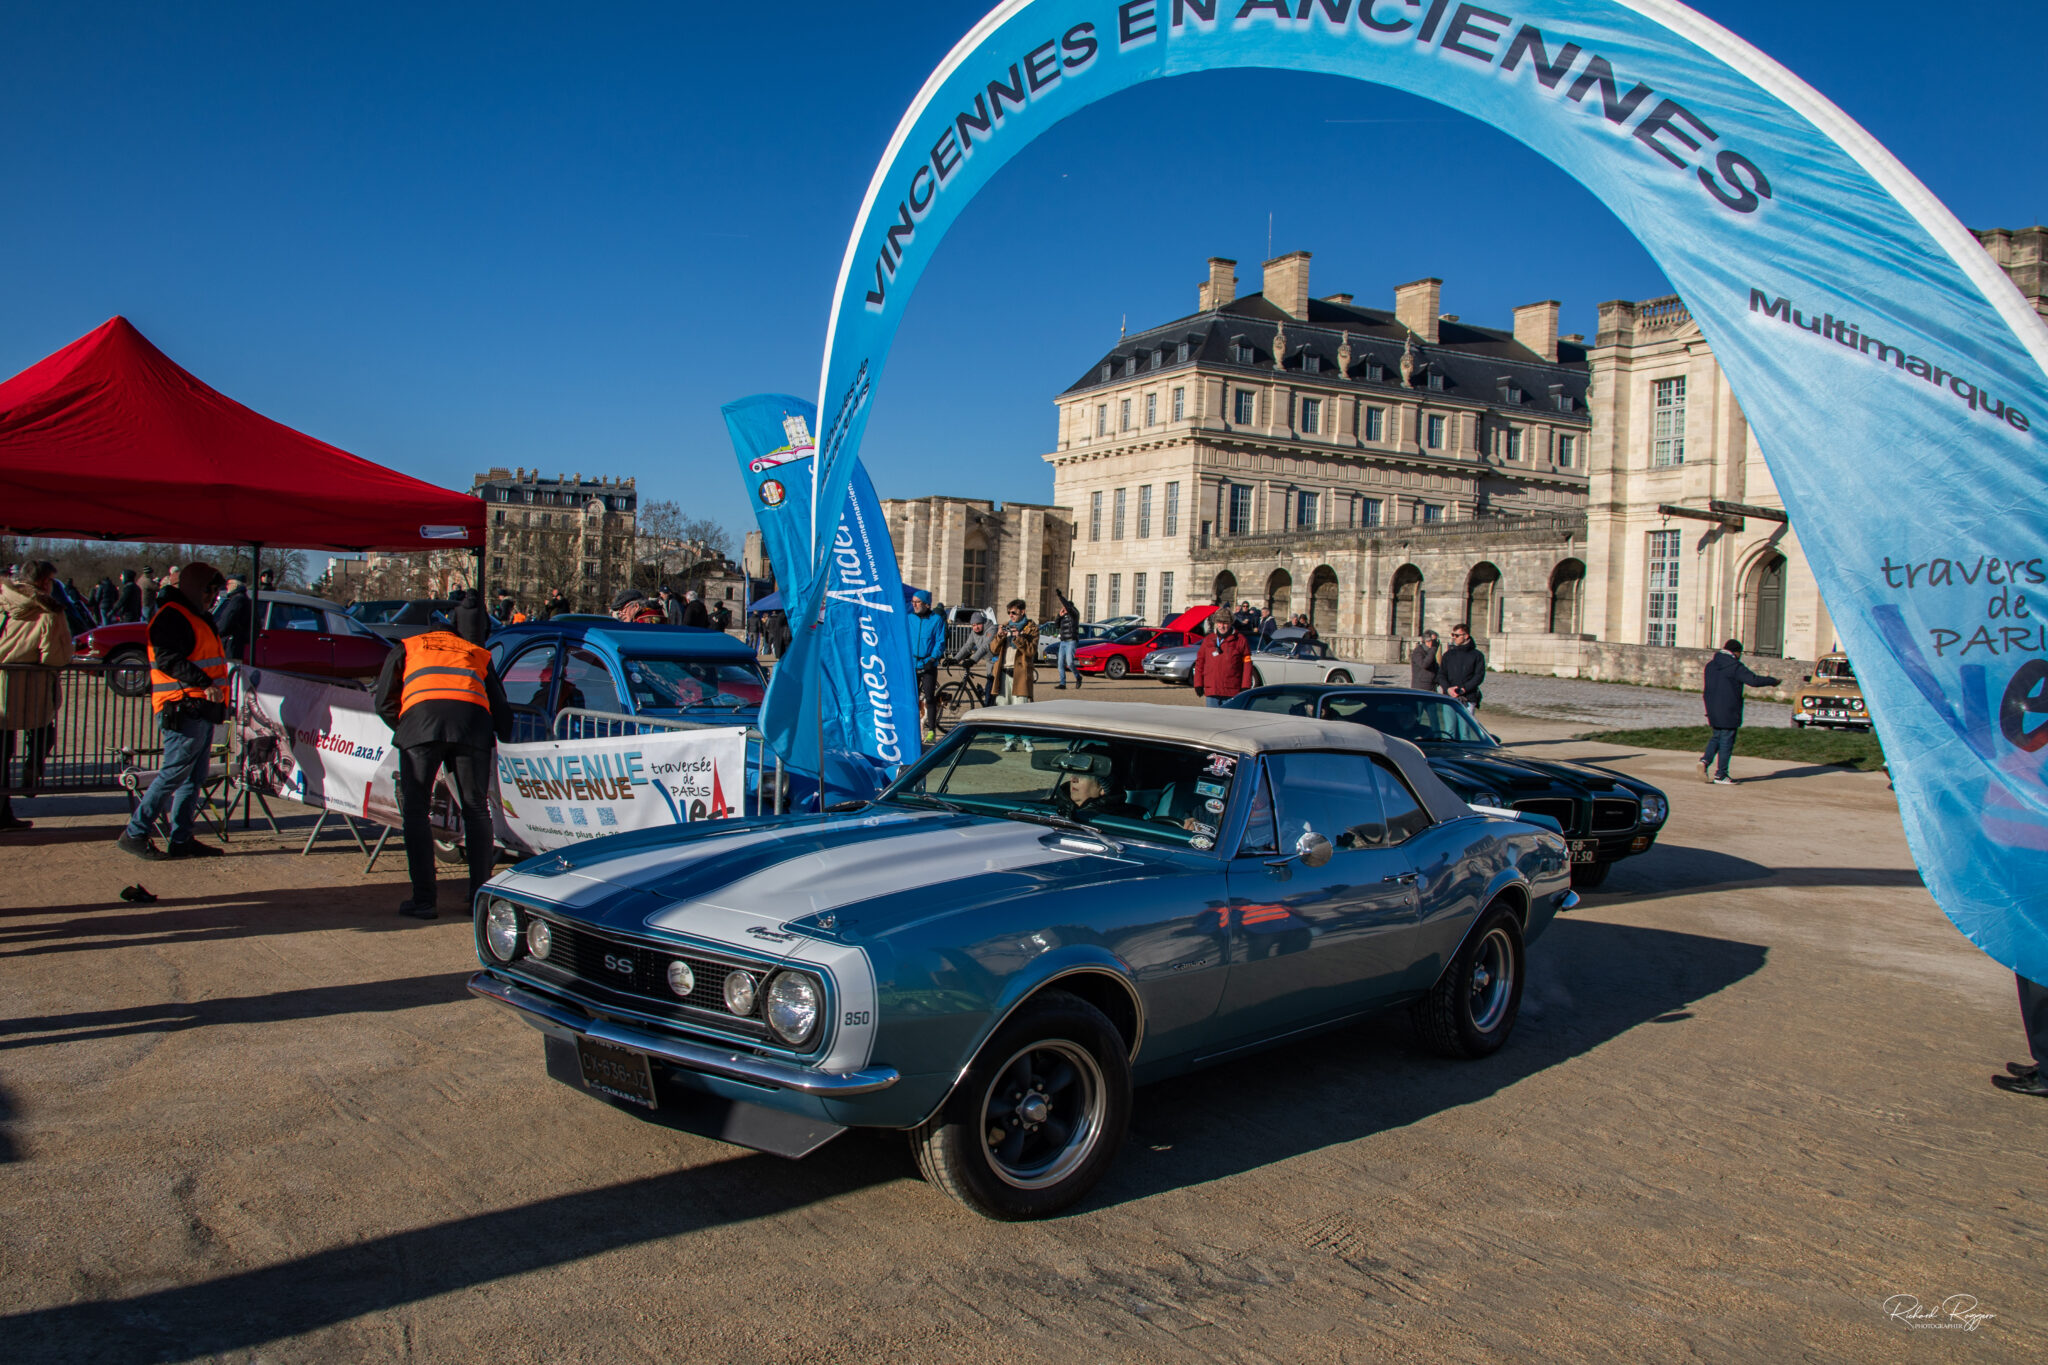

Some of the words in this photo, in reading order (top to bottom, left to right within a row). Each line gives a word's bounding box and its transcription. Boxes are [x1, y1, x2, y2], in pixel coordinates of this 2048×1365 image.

[866, 22, 1098, 306] VINCENNES
[1118, 0, 1216, 45] EN
[1749, 287, 2031, 433] Multimarque
[1880, 555, 2047, 589] travers
[1987, 585, 2031, 620] de
[858, 614, 880, 648] en
[297, 728, 384, 762] collection.axa.fr
[497, 751, 650, 788] BIENVENUE
[650, 756, 712, 775] traversée
[683, 773, 695, 786] de
[514, 776, 635, 801] BIENVENUE
[670, 785, 712, 798] PARIS
[564, 829, 574, 838] de
[575, 830, 594, 840] plus
[604, 954, 634, 974] SS
[844, 1010, 871, 1026] 350
